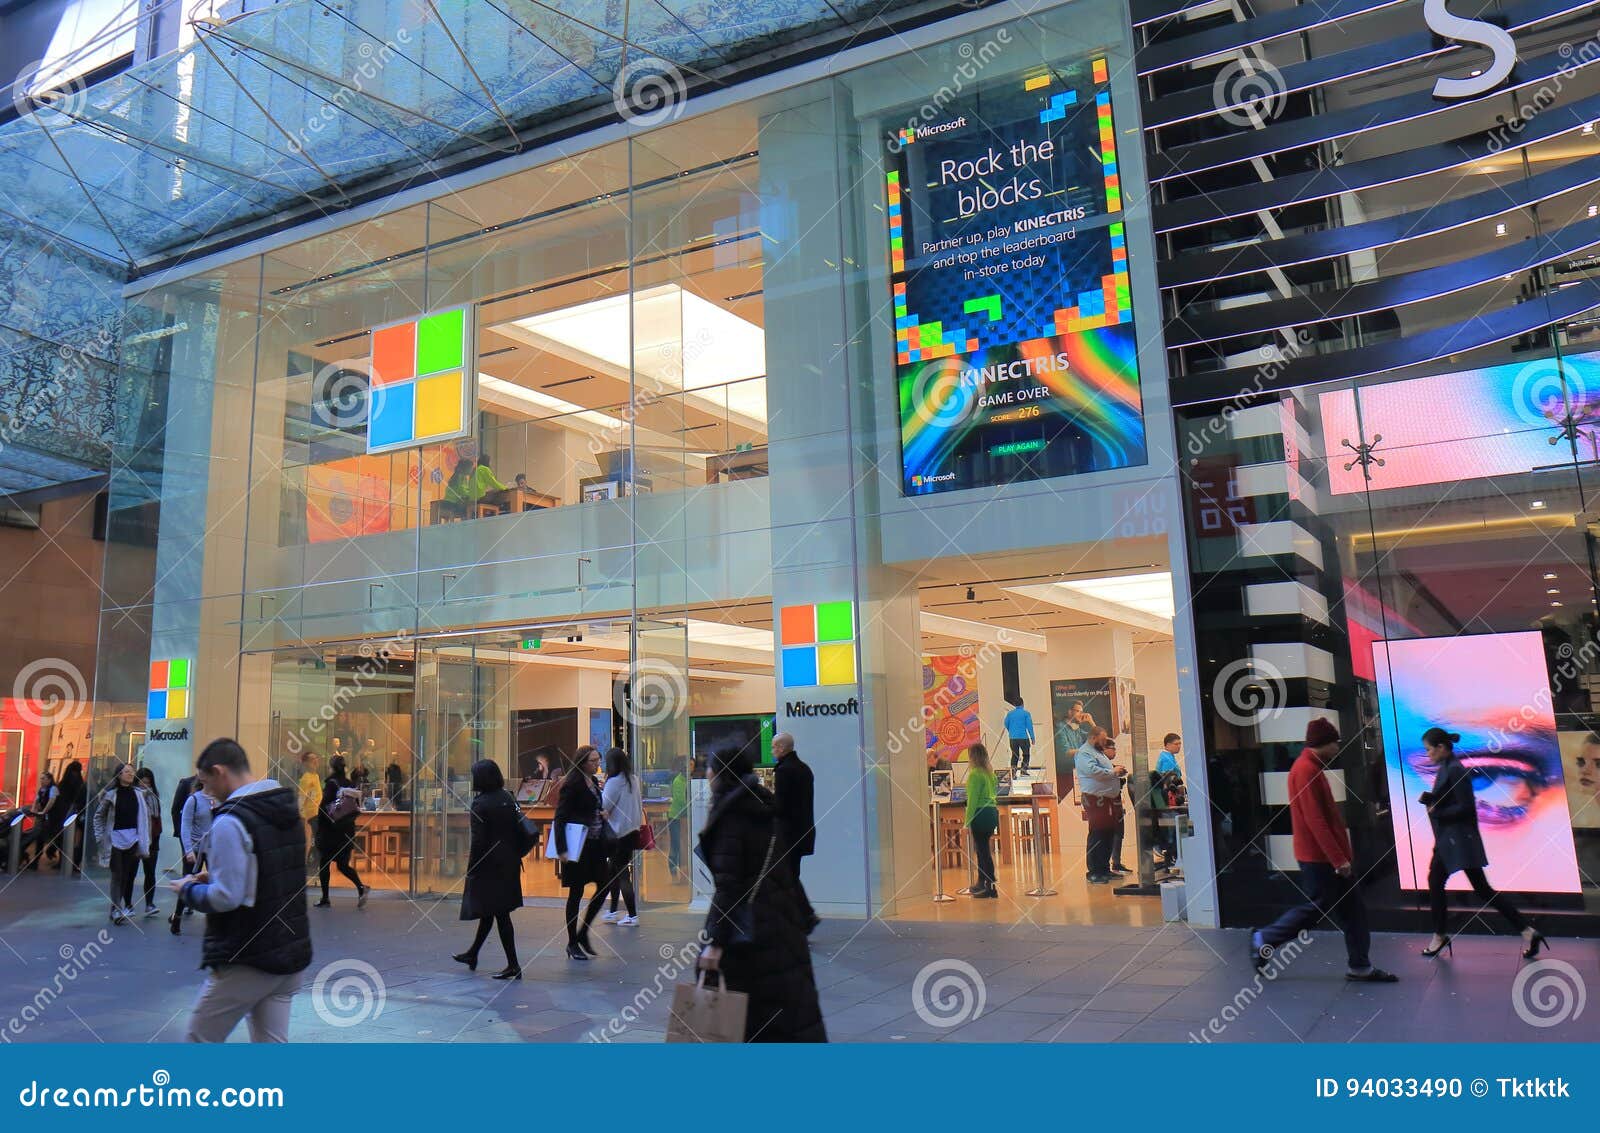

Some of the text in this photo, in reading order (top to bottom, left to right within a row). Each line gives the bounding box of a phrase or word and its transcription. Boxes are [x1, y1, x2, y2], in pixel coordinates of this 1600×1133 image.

[916, 116, 967, 139] Microsoft
[940, 139, 1054, 185] Rock the
[958, 176, 1042, 216] blocks
[922, 206, 1086, 254] Partner up, play KINECTRIS
[933, 227, 1077, 270] and top the leaderboard
[964, 253, 1046, 281] in-store today
[959, 352, 1070, 388] KINECTRIS
[978, 386, 1050, 408] GAME OVER
[1018, 406, 1040, 419] 276
[998, 441, 1039, 454] PLAY AGAIN
[923, 472, 955, 483] Microsoft
[786, 697, 858, 718] Microsoft
[150, 727, 188, 742] Microsoft
